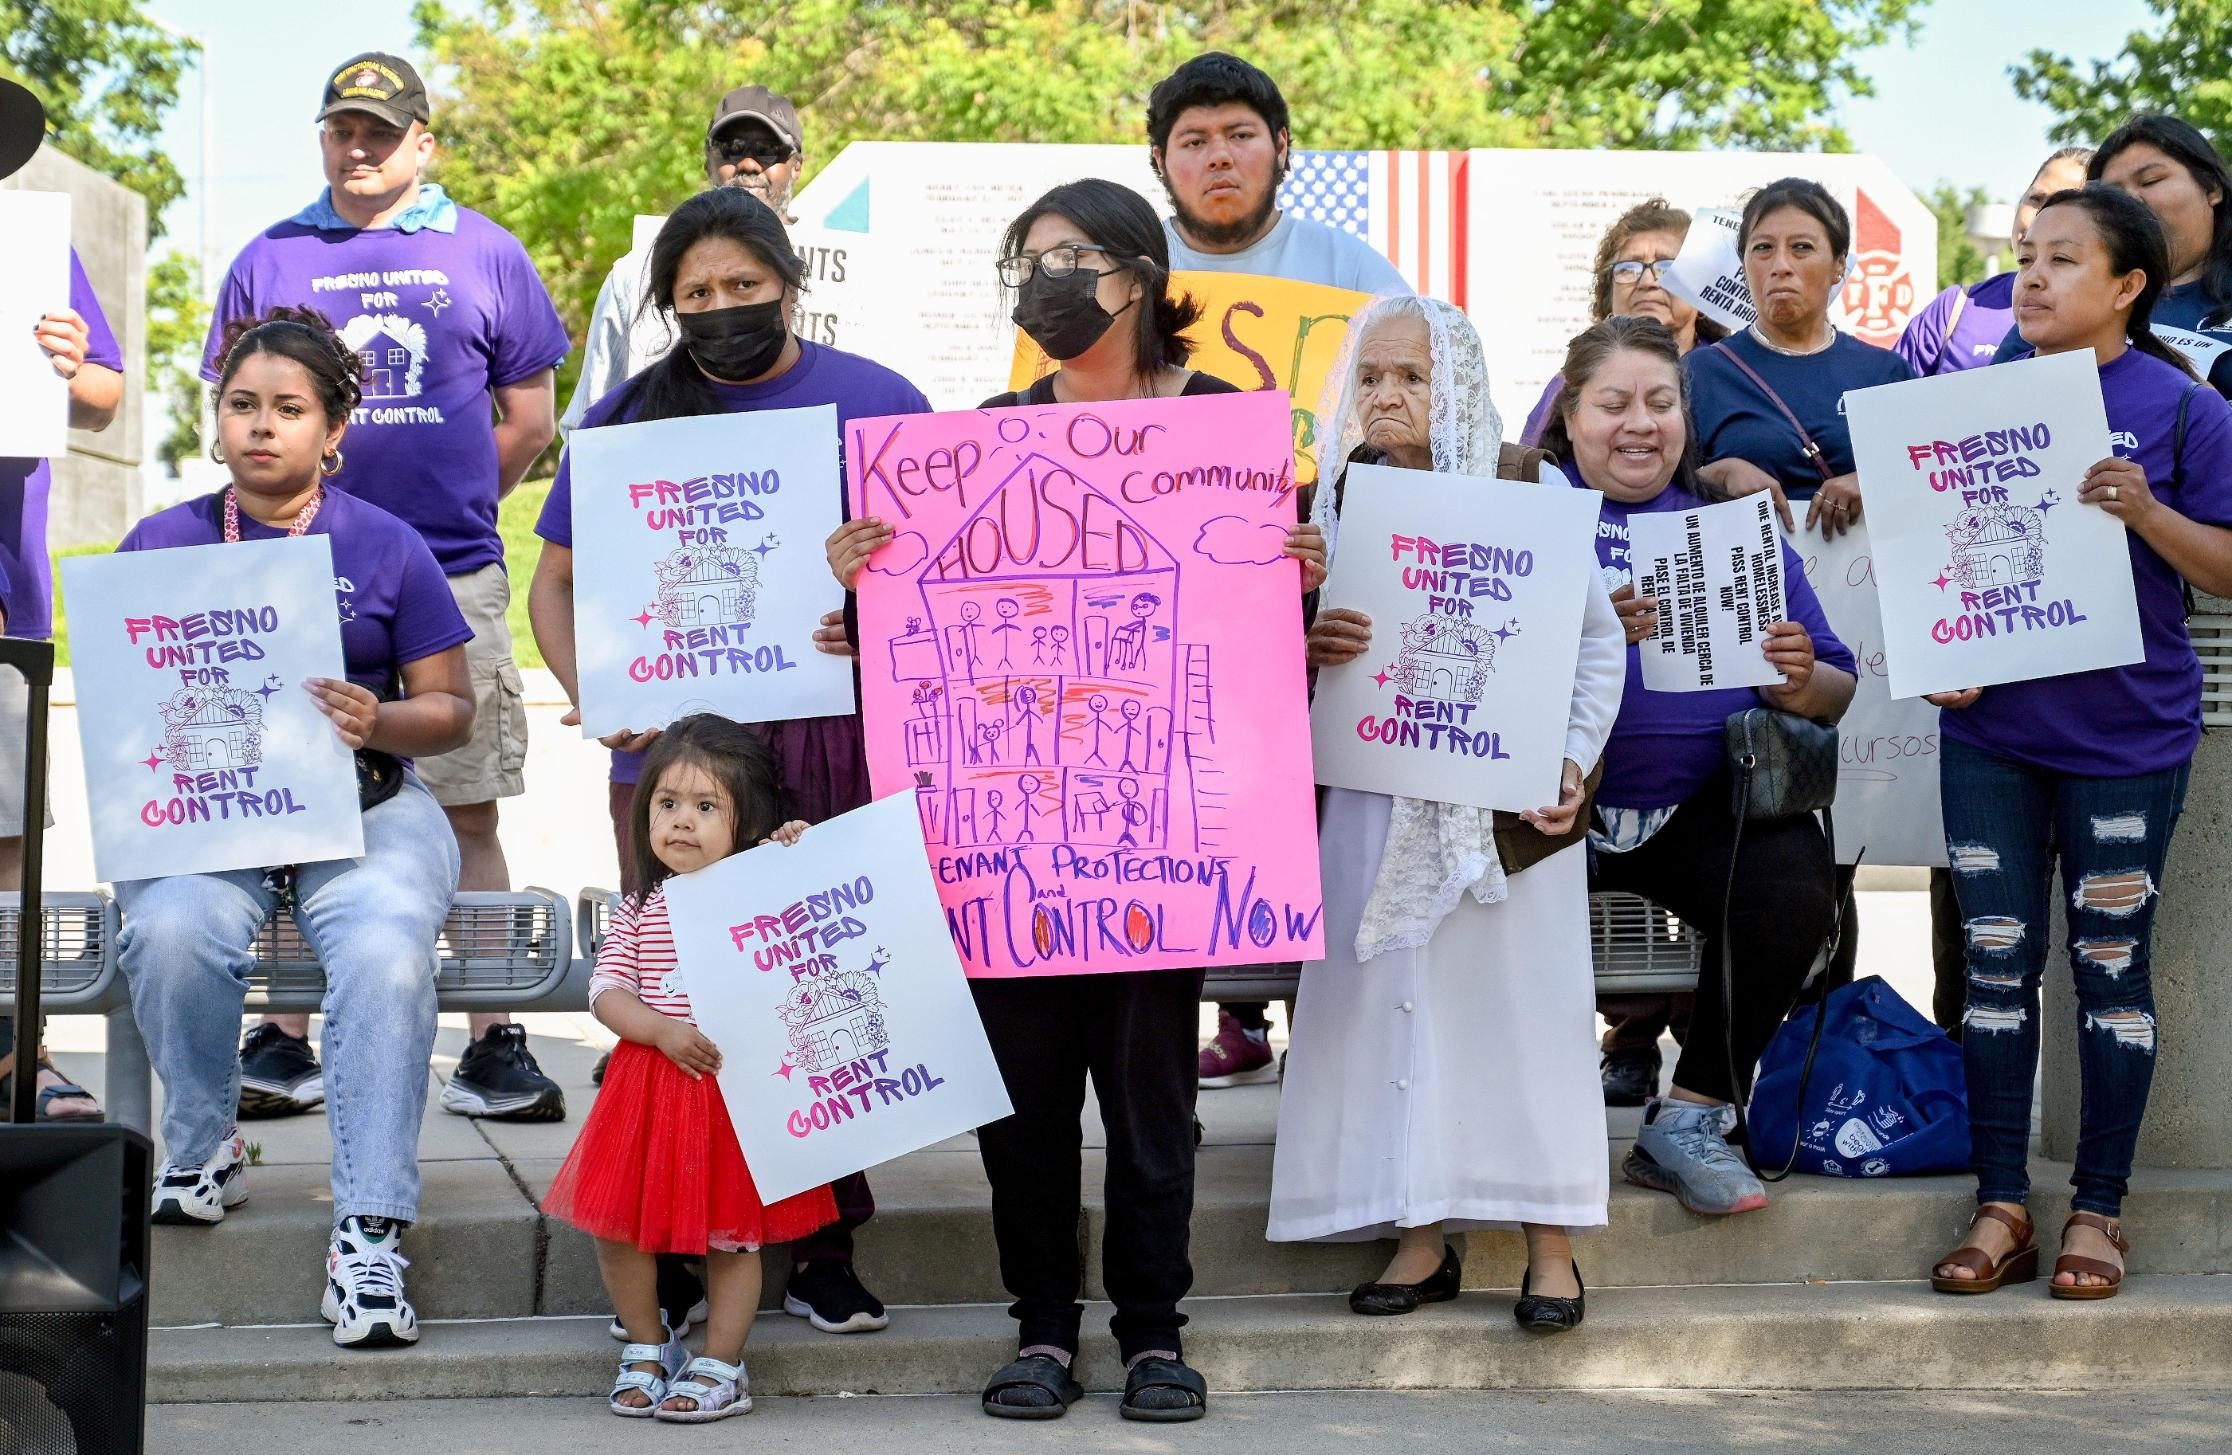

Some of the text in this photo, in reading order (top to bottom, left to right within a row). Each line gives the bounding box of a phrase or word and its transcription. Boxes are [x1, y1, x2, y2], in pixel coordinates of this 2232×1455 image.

[1713, 214, 1740, 232] TENE
[311, 271, 380, 293] FRESNO
[791, 245, 847, 283] NTS
[360, 292, 399, 309] FOR
[1700, 285, 1759, 324] RENTA AHO
[1715, 275, 1756, 308] CONTRO
[371, 406, 445, 425] CONTROL
[855, 412, 1167, 518] Keep Our
[1907, 422, 2051, 471] FRESNO
[628, 469, 780, 509] FRESNO
[1962, 485, 2009, 508] FOR
[936, 467, 1149, 581] HOUSED
[1757, 500, 1770, 523] ONE
[678, 526, 728, 548] FOR
[1390, 533, 1534, 577] FRESNO
[1760, 523, 1776, 563] RENTAL
[1429, 594, 1475, 618] FOR
[1641, 575, 1656, 599] RENT
[1654, 557, 1676, 654] PASE EL CONTROL DE
[1674, 552, 1696, 655] LA FALTA DE VIVIENDA
[1685, 514, 1714, 686] UN AUMENTO DE ALQUILER CERCA DE
[1720, 585, 1735, 612] NOW!
[1731, 545, 1753, 646] PASS RENT CONTROL
[1751, 552, 1771, 632] HOMELESSNESS
[1766, 563, 1781, 613] INCREASE
[1961, 579, 2042, 612] RENT
[124, 605, 279, 645] FRESNO
[662, 622, 752, 651] RENT
[1931, 599, 2088, 644] CONTROL
[179, 666, 230, 688] FOR
[628, 644, 798, 683] CONTROL
[1394, 694, 1477, 725] RENT
[1356, 714, 1511, 760] CONTROL
[172, 766, 260, 795] RENT
[140, 786, 306, 827] CONTROL
[931, 845, 1033, 884] ENANT
[1036, 883, 1067, 900] and
[728, 875, 874, 953] FRESNO
[1003, 863, 1198, 969] CONTROL
[789, 953, 839, 985] FOR
[807, 1047, 889, 1098] RENT
[786, 1062, 945, 1139] CONTROL
